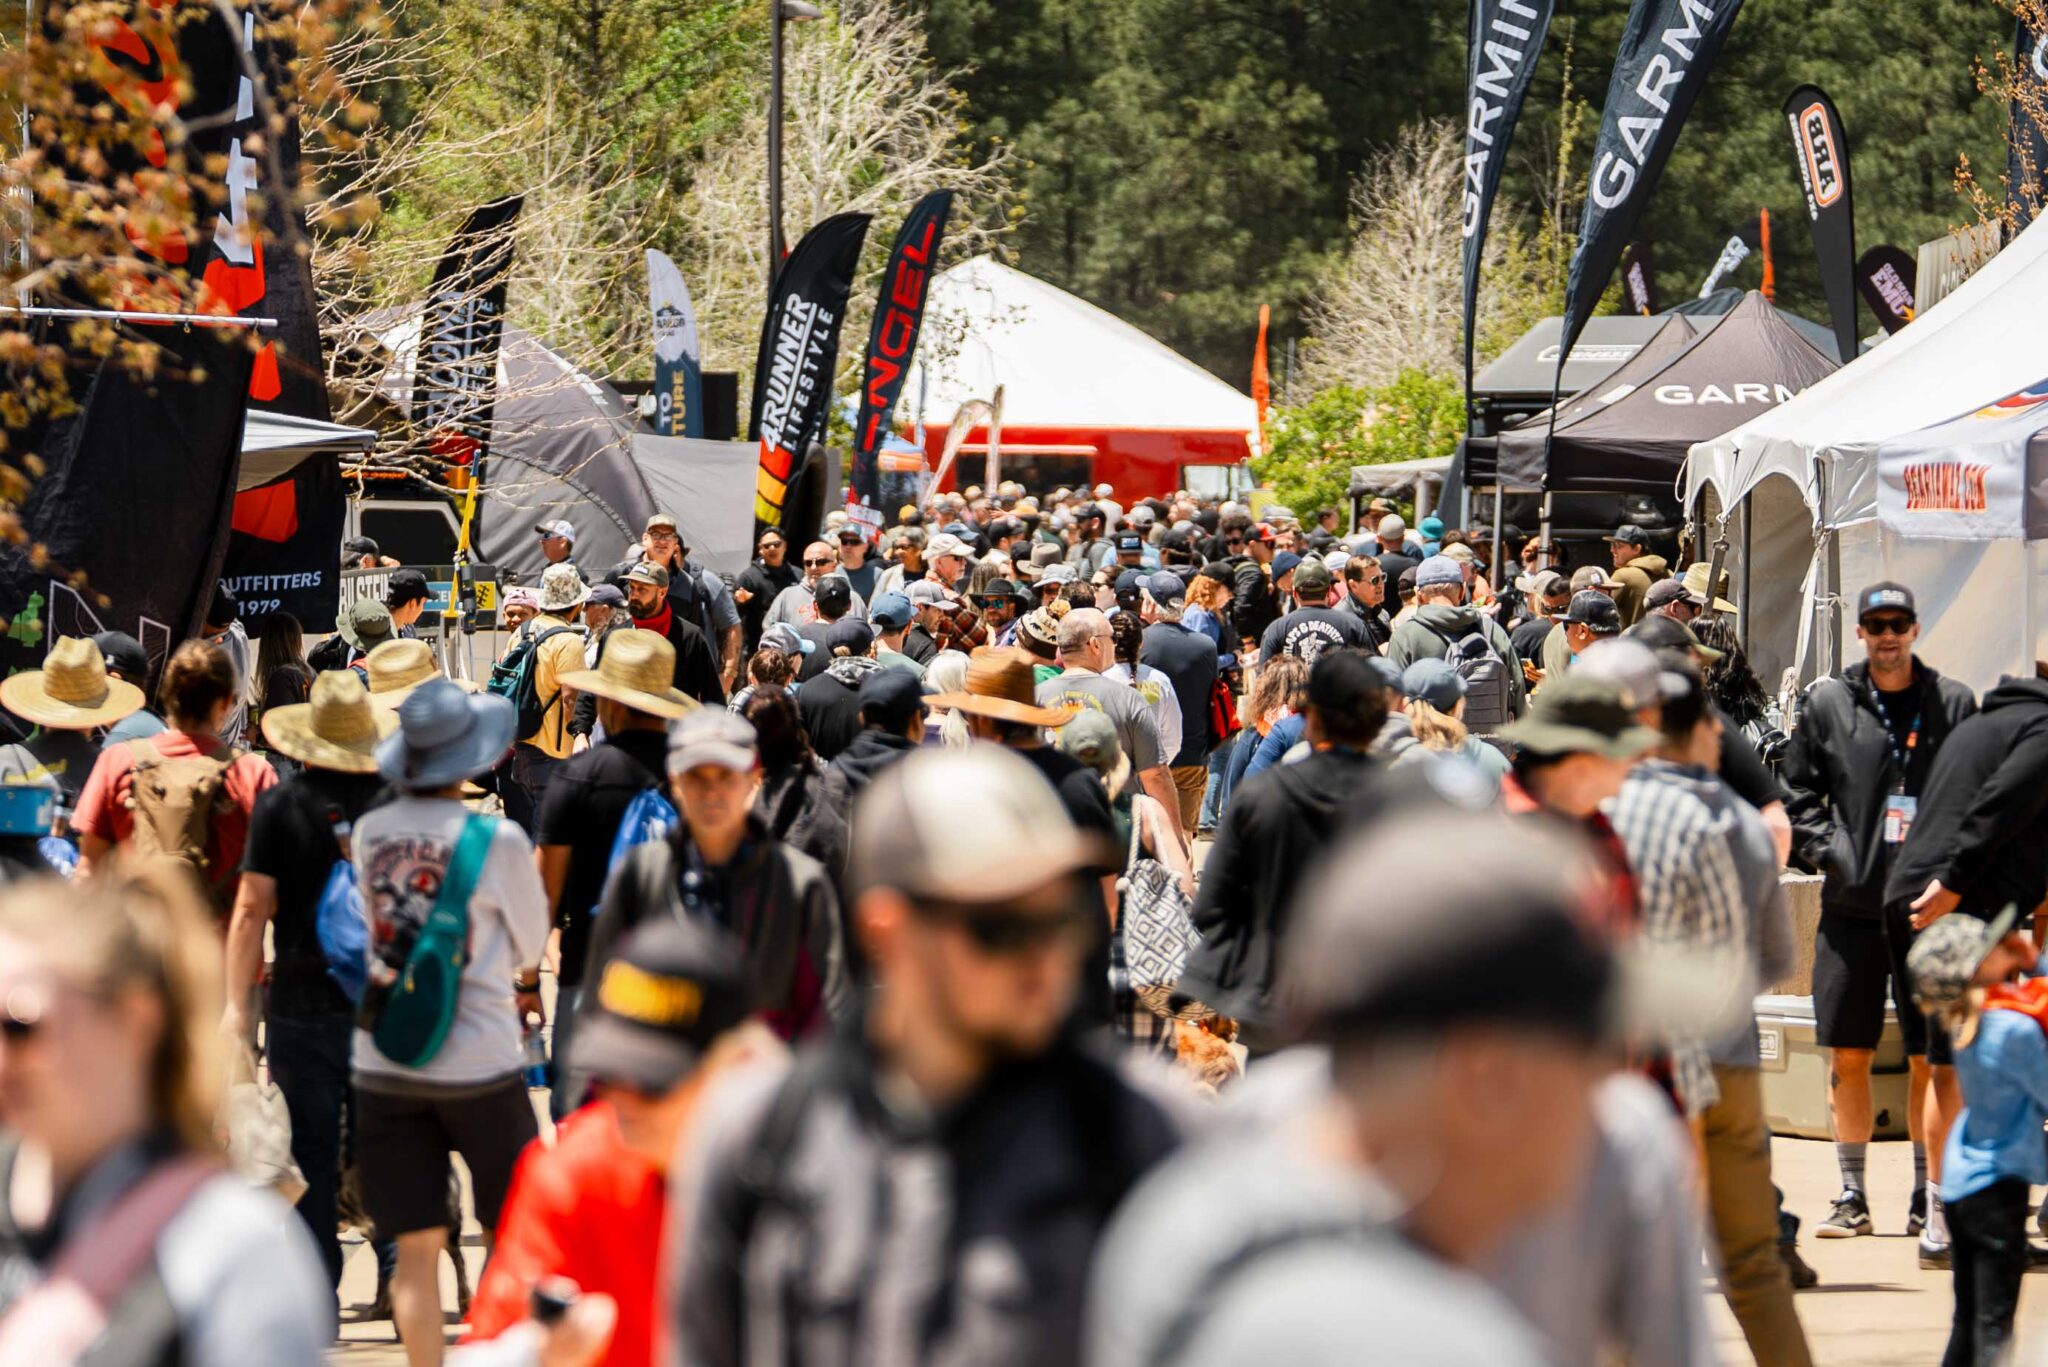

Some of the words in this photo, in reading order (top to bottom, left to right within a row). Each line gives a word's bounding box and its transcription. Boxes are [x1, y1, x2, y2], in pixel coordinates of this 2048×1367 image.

[1869, 267, 1907, 316] EMU
[759, 292, 812, 454] 4RUNNER
[781, 306, 835, 452] LIFESTYLE
[659, 391, 672, 428] TO
[671, 369, 687, 438] TURE
[216, 571, 322, 592] OUTFITTERS
[237, 599, 281, 617] 1979
